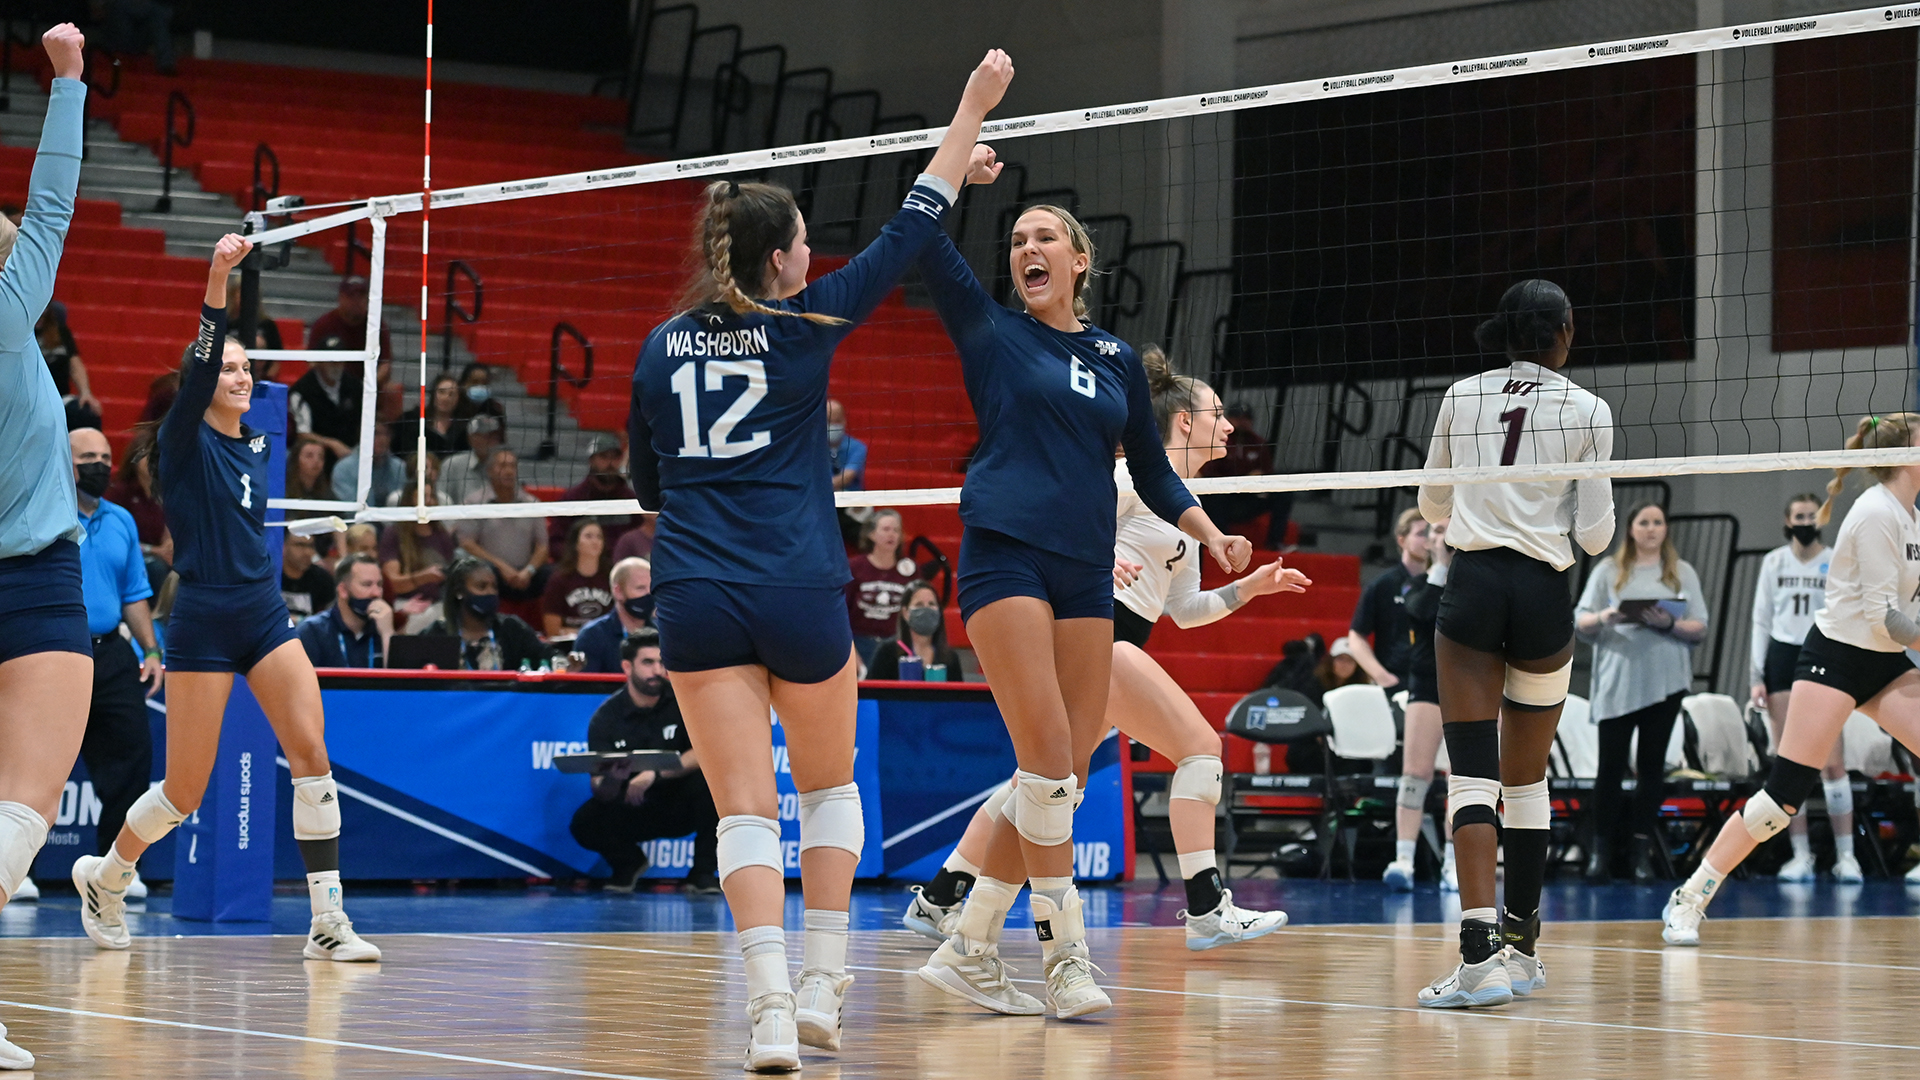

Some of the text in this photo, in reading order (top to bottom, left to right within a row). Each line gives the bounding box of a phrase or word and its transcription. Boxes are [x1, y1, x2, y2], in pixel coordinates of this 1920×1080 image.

[1742, 20, 1817, 38] VOLLEYBALL CHAMPIONSHIP
[1596, 40, 1669, 56] VOLLEYBALL CHAMPIONSHIP
[1460, 58, 1528, 74] VOLLEYBALL CHAMPIONSHIP
[1330, 74, 1394, 90] VOLLEYBALL CHAMPIONSHIP
[1207, 90, 1268, 106] VOLLEYBALL CHAMPIONSHIP
[1091, 105, 1149, 119] VOLLEYBALL CHAMPIONSHIP
[981, 120, 1036, 133] VOLLEYBALL CHAMPIONSHIP
[666, 325, 769, 357] WASHBURN
[1070, 355, 1096, 399] 6
[1502, 379, 1543, 396] WT
[671, 359, 772, 458] 12
[1498, 406, 1528, 466] 1
[240, 473, 252, 509] 1
[1165, 539, 1186, 571] 2
[1793, 593, 1809, 615] 11
[238, 752, 251, 850] sports imports
